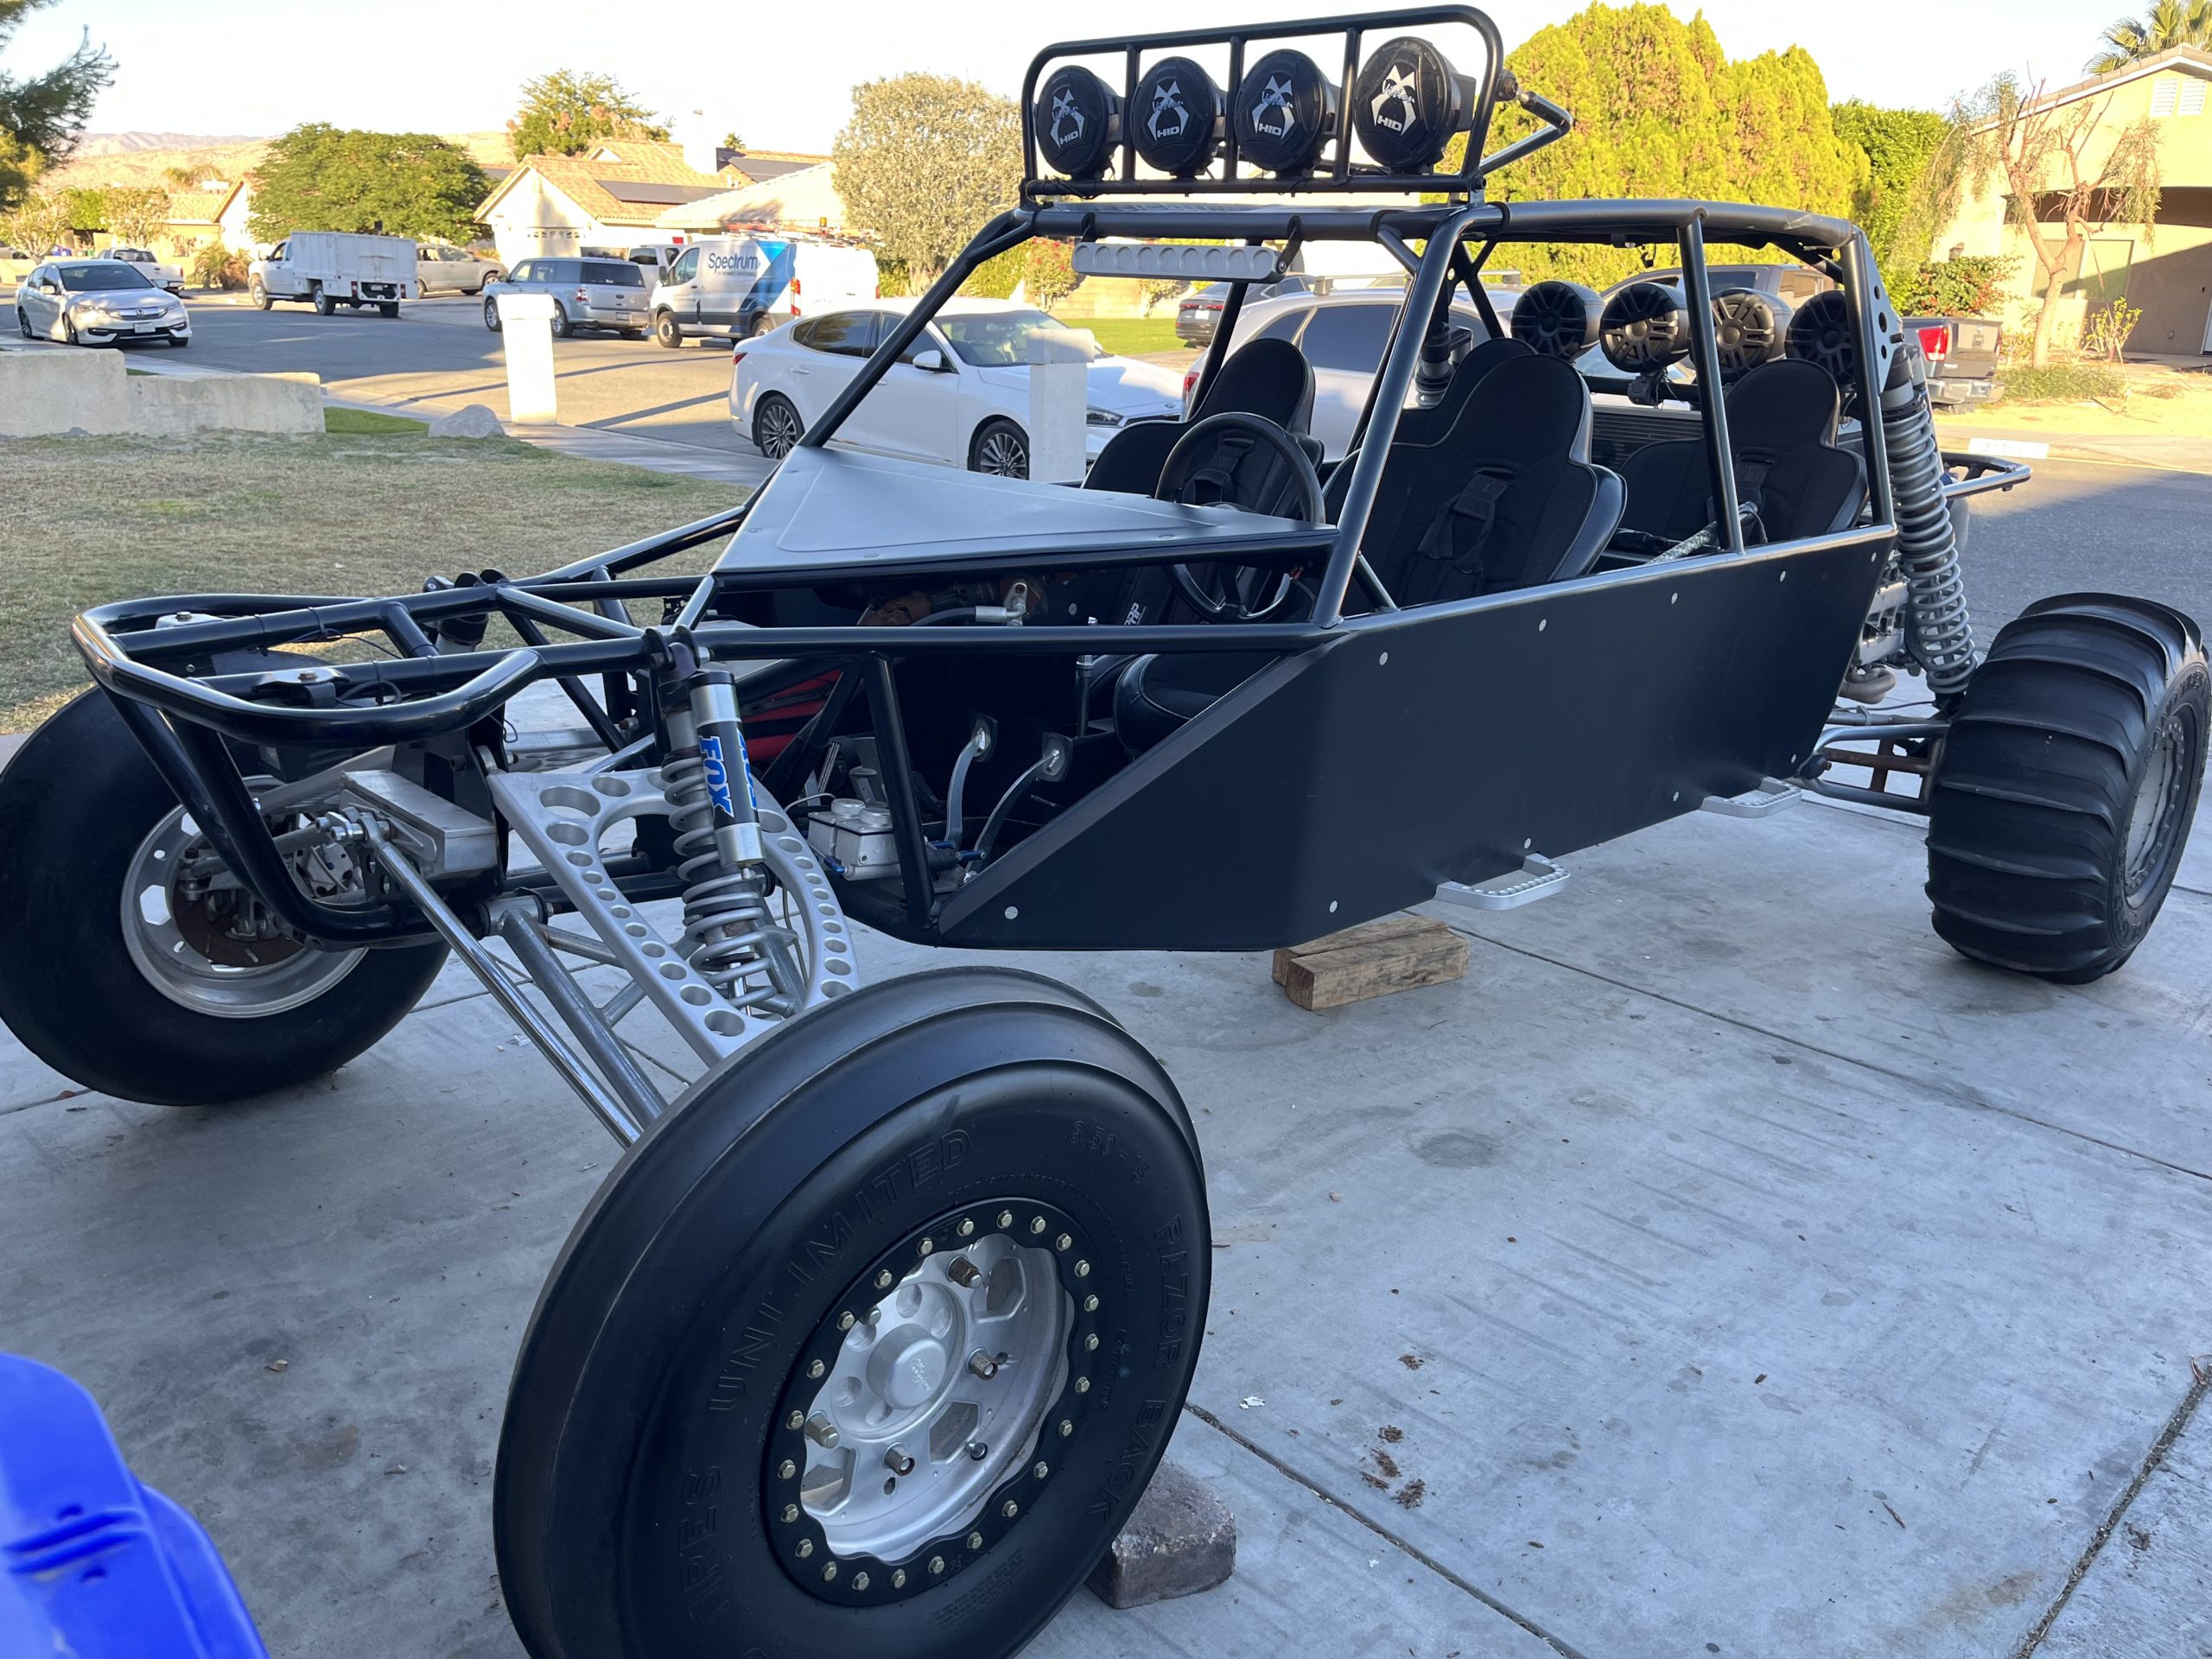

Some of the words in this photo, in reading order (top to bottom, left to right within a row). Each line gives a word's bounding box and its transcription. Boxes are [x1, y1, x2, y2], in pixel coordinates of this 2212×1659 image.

[1258, 123, 1282, 137] HID
[1376, 115, 1402, 131] HID
[1059, 130, 1079, 145] HID
[1157, 126, 1180, 137] HID
[709, 252, 758, 272] Spectrum
[698, 735, 734, 818] FOX
[1090, 1399, 1166, 1523] BACK
